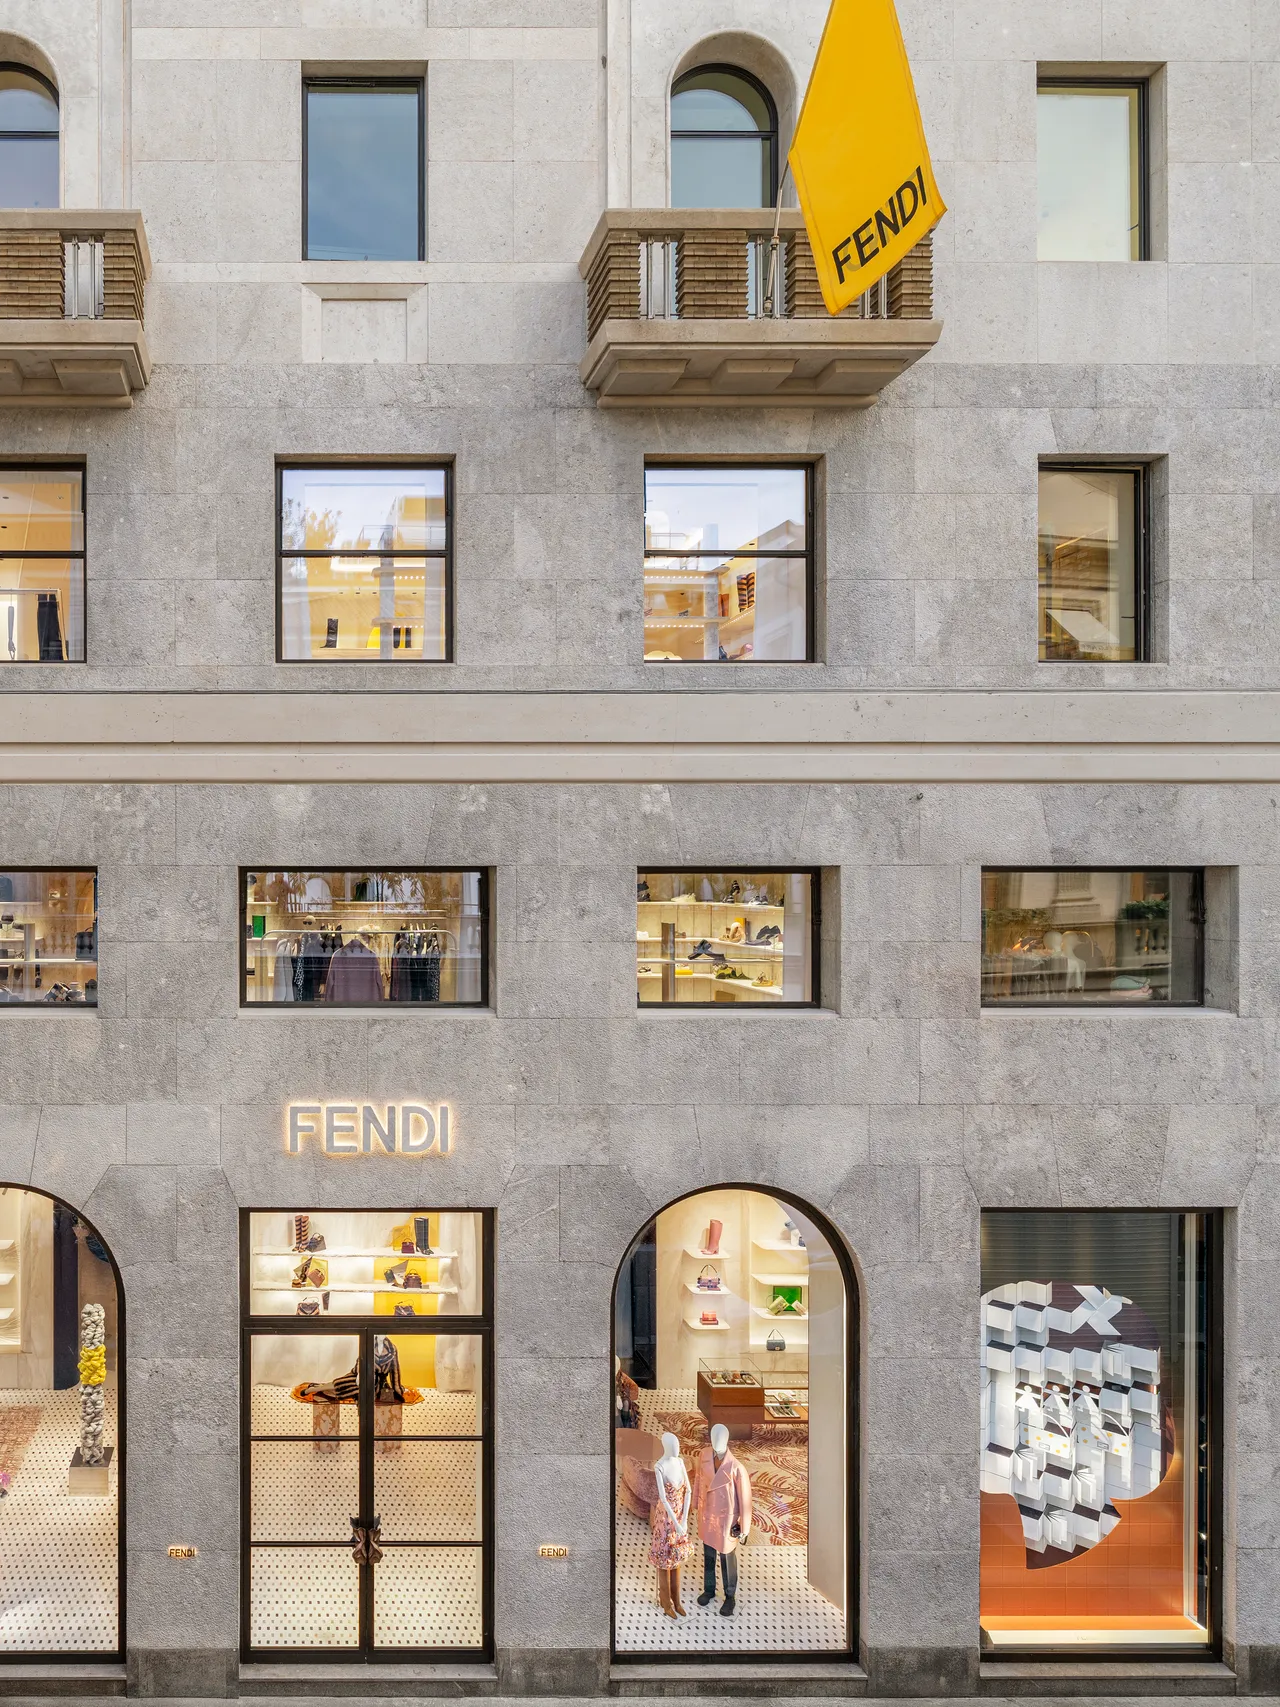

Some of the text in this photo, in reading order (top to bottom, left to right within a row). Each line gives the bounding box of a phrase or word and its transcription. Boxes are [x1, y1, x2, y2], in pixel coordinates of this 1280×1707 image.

[831, 165, 927, 285] FENDI
[289, 1105, 449, 1153] FENDI
[169, 1548, 195, 1557] FENDI
[541, 1547, 567, 1557] FENDI
